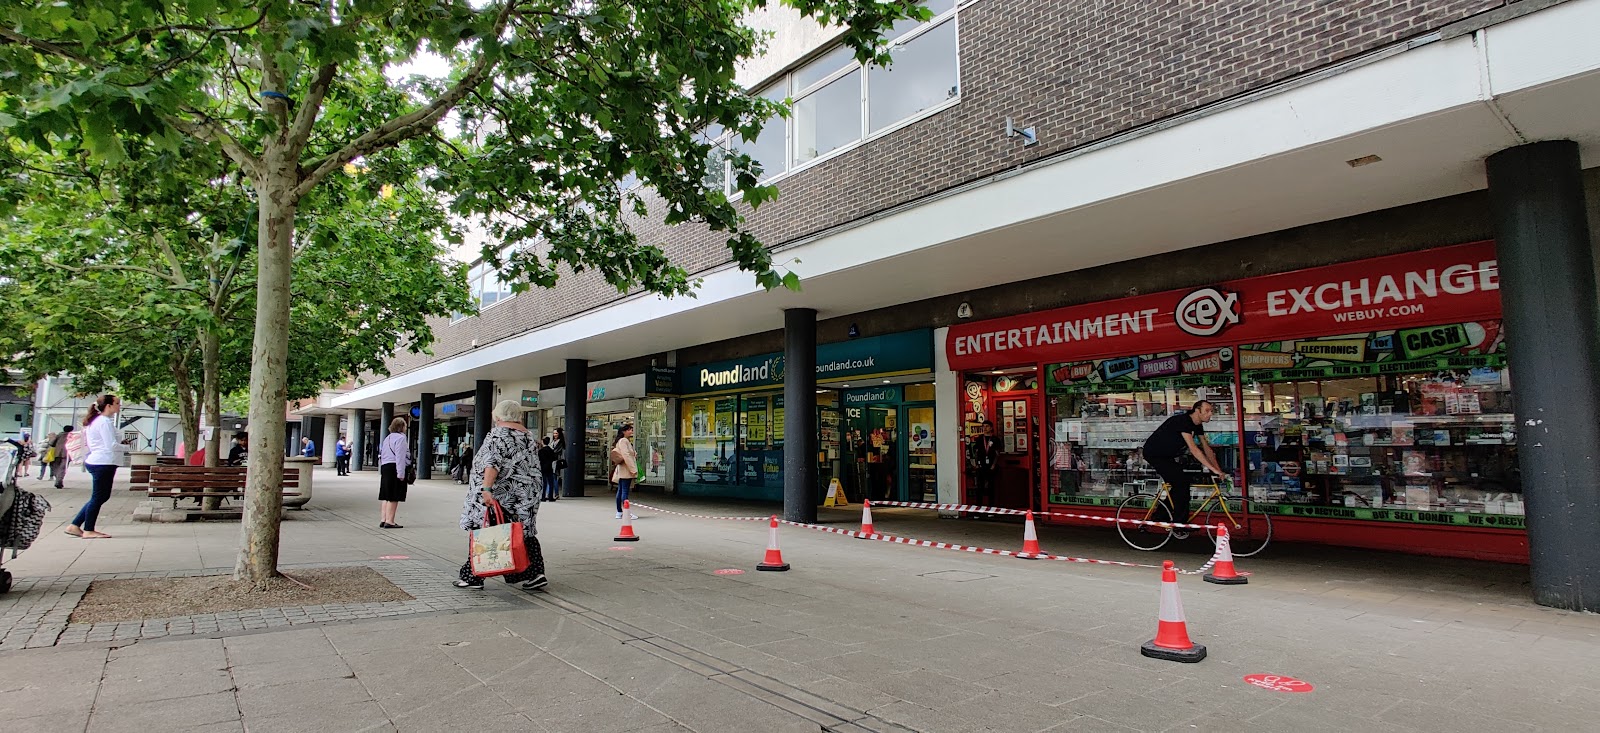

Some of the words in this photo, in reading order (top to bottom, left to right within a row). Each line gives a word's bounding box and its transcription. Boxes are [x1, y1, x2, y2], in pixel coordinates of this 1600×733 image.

[1266, 260, 1500, 317] EXCHANGE
[1333, 303, 1424, 323] WEBUY.COM
[955, 308, 1159, 356] ENTERTAINMENT
[1074, 366, 1088, 376] BUY
[1109, 360, 1135, 373] GAMES
[1143, 361, 1174, 373] PHONES
[1184, 356, 1219, 373] MOVIES
[1241, 355, 1290, 365] COMPUTERS
[1301, 345, 1358, 354] ELECTRONICS
[1374, 337, 1389, 348] for
[1406, 326, 1461, 351] CASH
[700, 360, 769, 388] Poundland
[815, 356, 875, 373] oundland.co.uk
[1281, 369, 1325, 378] COMPUTING
[1332, 366, 1350, 374] FILM
[1360, 365, 1370, 374] TV
[1379, 359, 1438, 372] ELECTRONICS
[846, 390, 885, 402] Poundland
[762, 463, 780, 473] Value
[1253, 504, 1280, 513] DONATE
[1293, 506, 1304, 514] WE
[1314, 507, 1356, 517] RECYCLING
[1372, 510, 1390, 520] BUY
[1394, 511, 1414, 521] SELL
[1418, 512, 1455, 523] DONATE
[1468, 515, 1484, 525] WE
